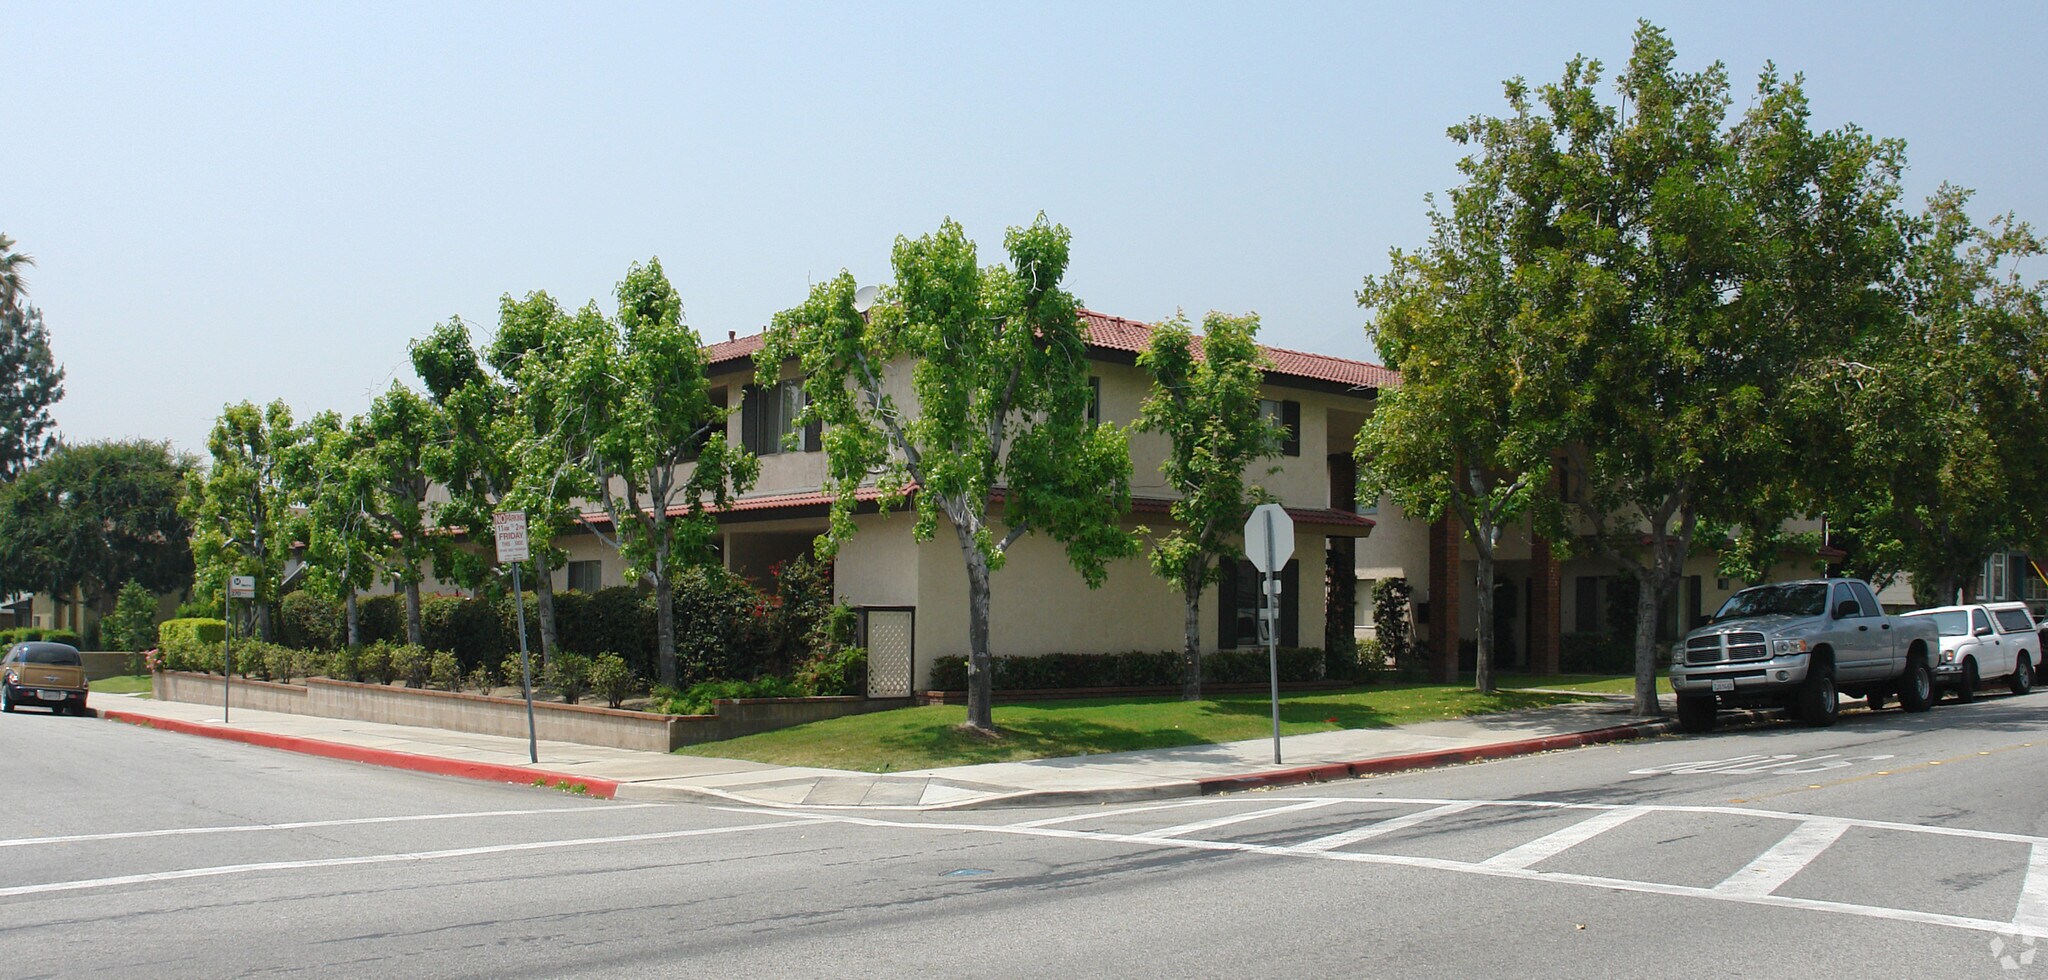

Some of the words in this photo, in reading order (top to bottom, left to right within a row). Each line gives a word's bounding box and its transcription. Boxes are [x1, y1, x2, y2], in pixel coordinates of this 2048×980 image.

[495, 514, 506, 524] NO
[499, 532, 523, 540] FRIDAY
[1628, 754, 1894, 774] STOP
